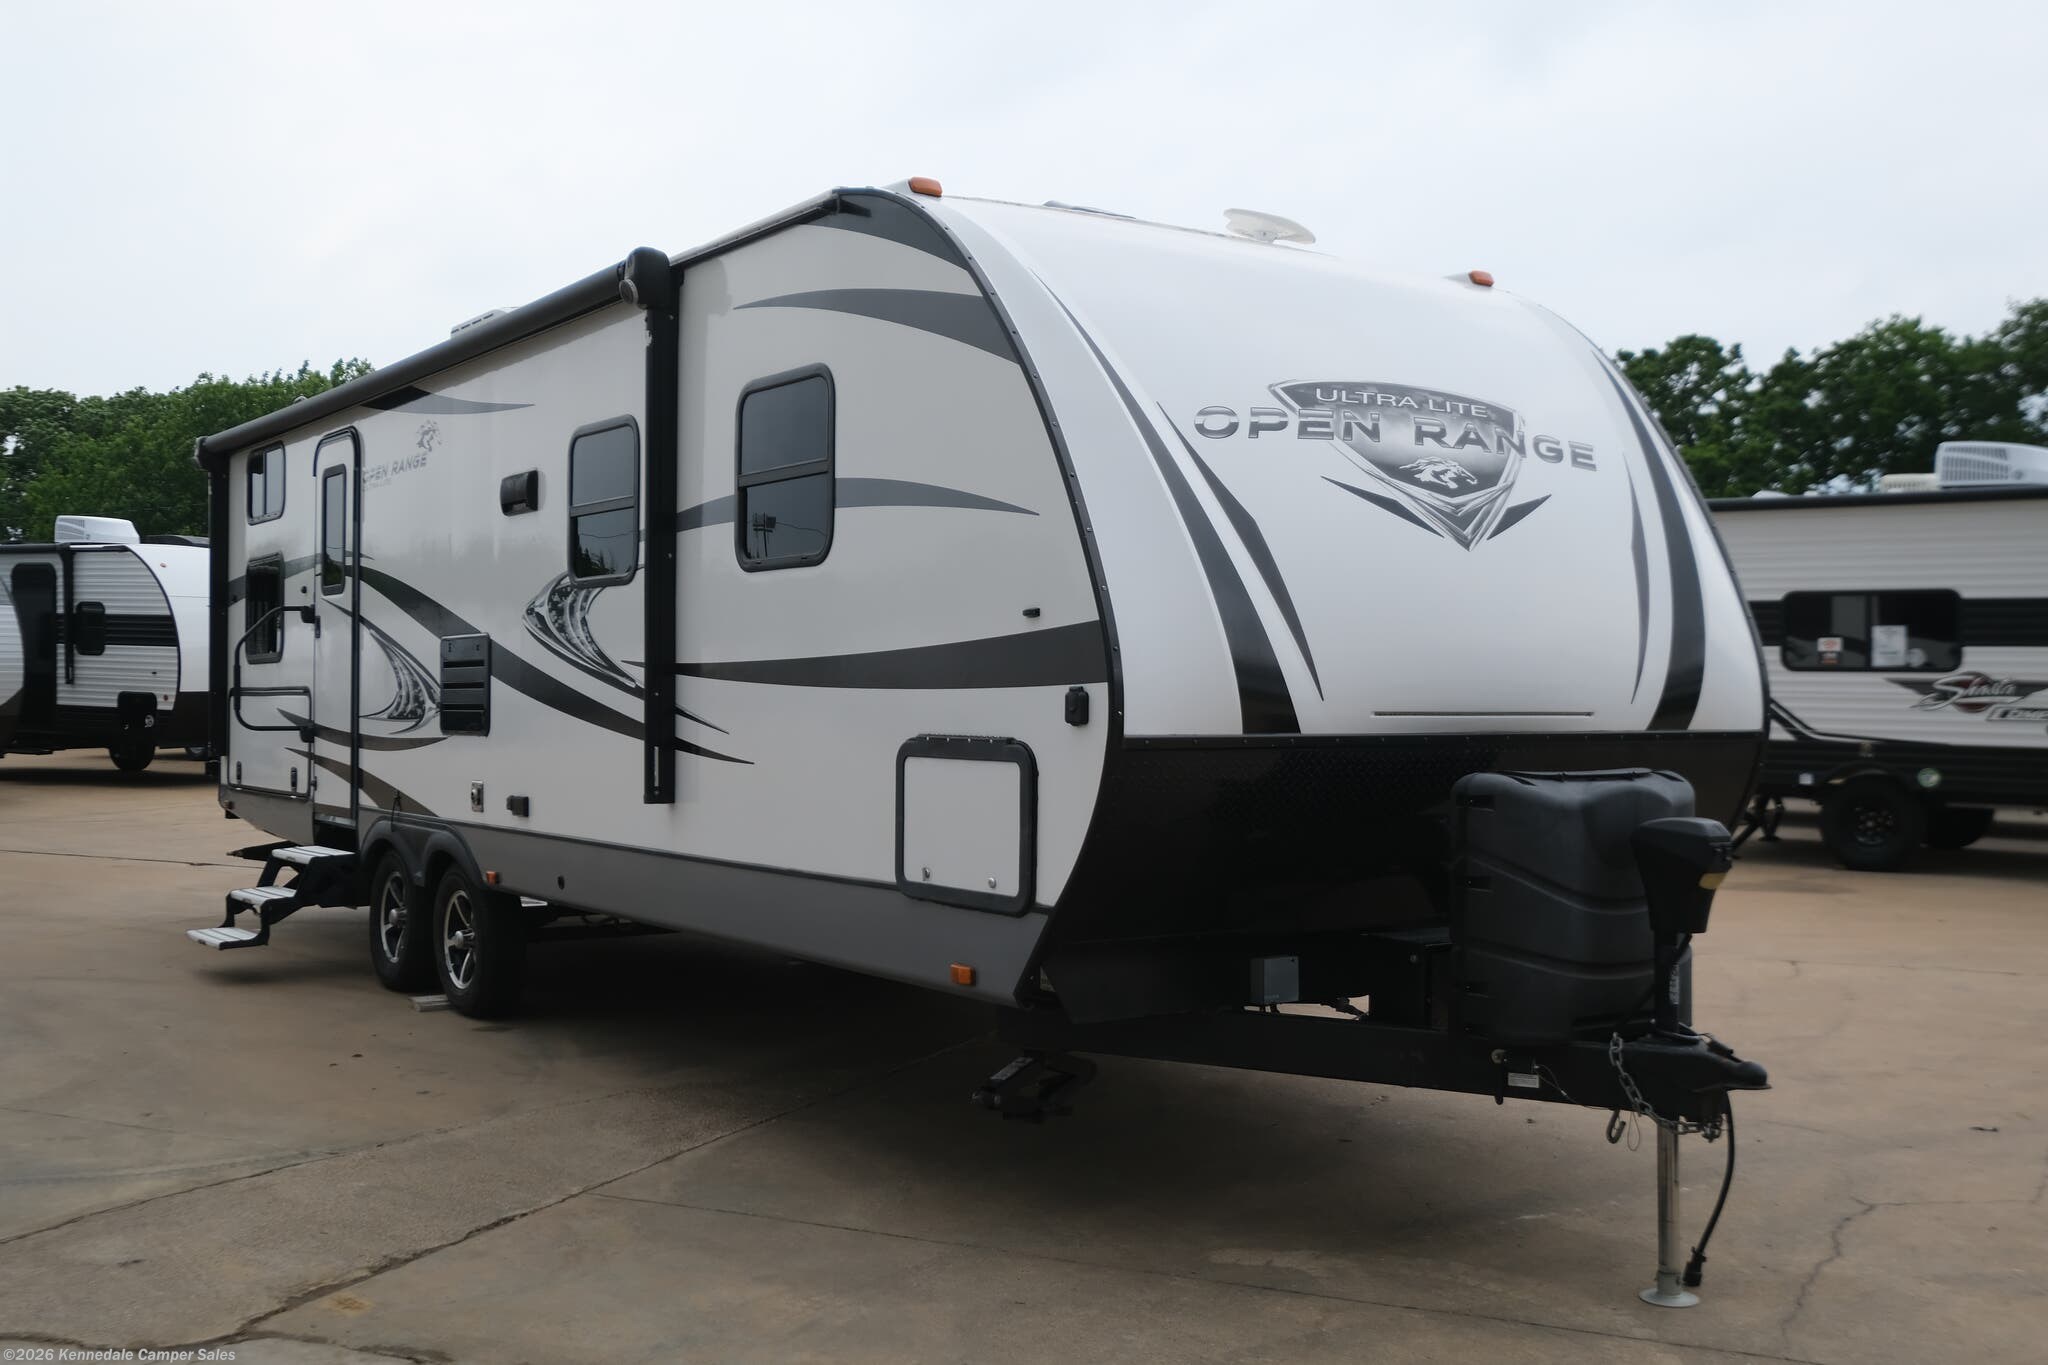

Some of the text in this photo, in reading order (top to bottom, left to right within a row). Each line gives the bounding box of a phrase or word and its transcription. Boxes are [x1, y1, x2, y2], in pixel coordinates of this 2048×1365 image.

[1316, 388, 1488, 417] ULTRA LITE
[1194, 405, 1598, 472] OPEN RANGE
